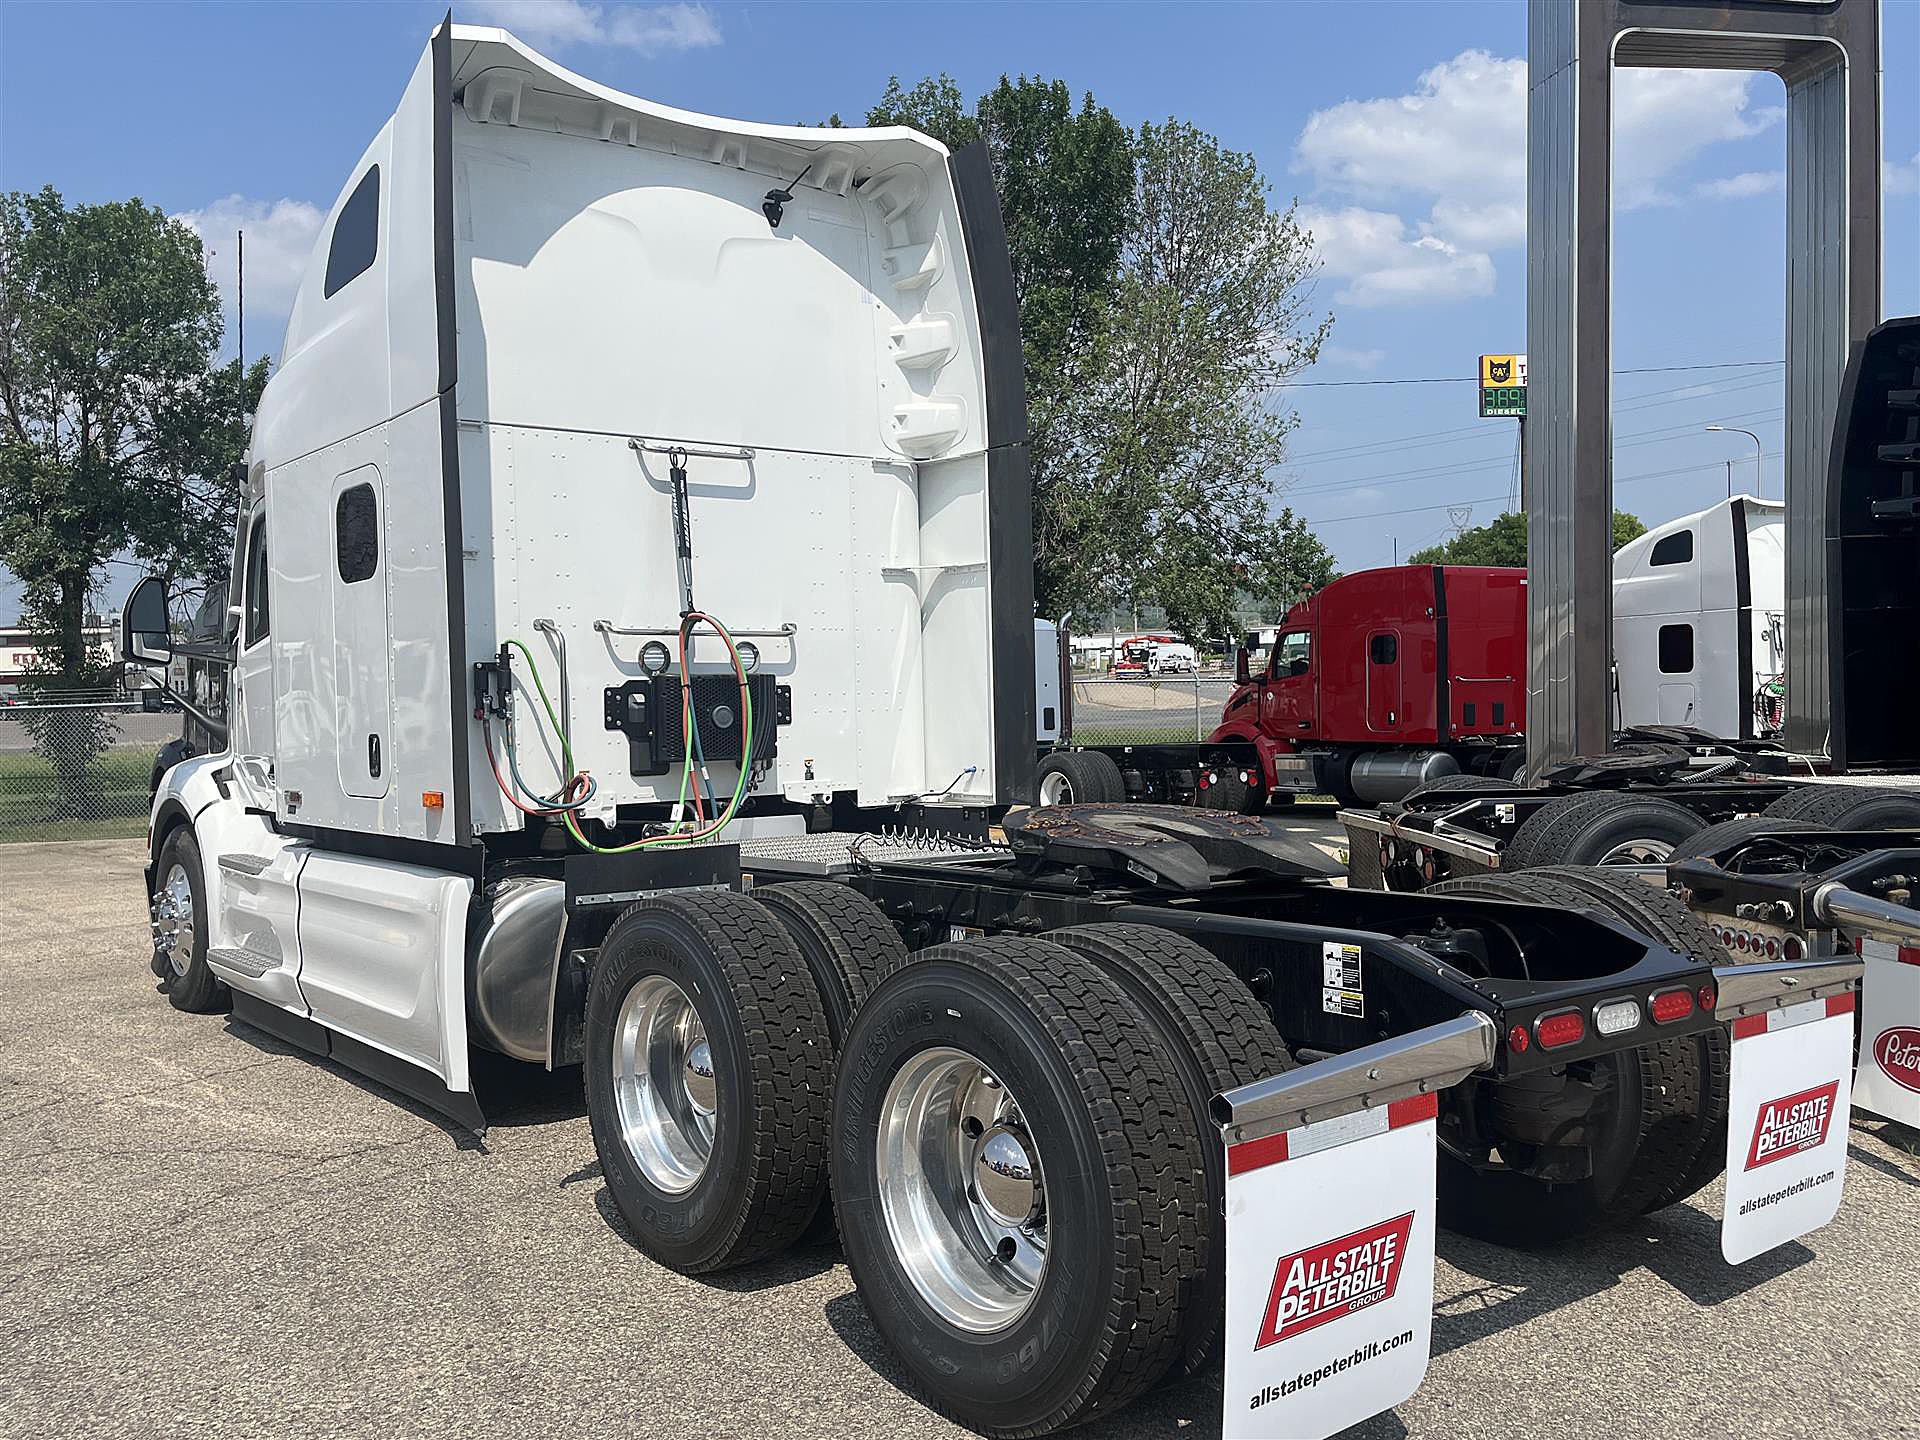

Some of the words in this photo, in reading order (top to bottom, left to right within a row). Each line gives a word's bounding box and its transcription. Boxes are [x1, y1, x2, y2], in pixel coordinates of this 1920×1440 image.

[1492, 367, 1507, 377] CAT
[1486, 408, 1523, 416] DIESEL
[842, 1000, 934, 1166] BRIDGESTONE
[1755, 1114, 1826, 1161] PETERBILT
[1760, 1095, 1829, 1134] ALLSTATE
[1798, 1137, 1821, 1150] GROUP
[1739, 1170, 1834, 1216] allstatepeterbilt.com
[1281, 1233, 1398, 1298] ALLSTATE
[1274, 1258, 1394, 1335] PETERBILT
[1349, 1289, 1386, 1310] GROUP
[1250, 1329, 1413, 1410] allstatepeterbilt.com
